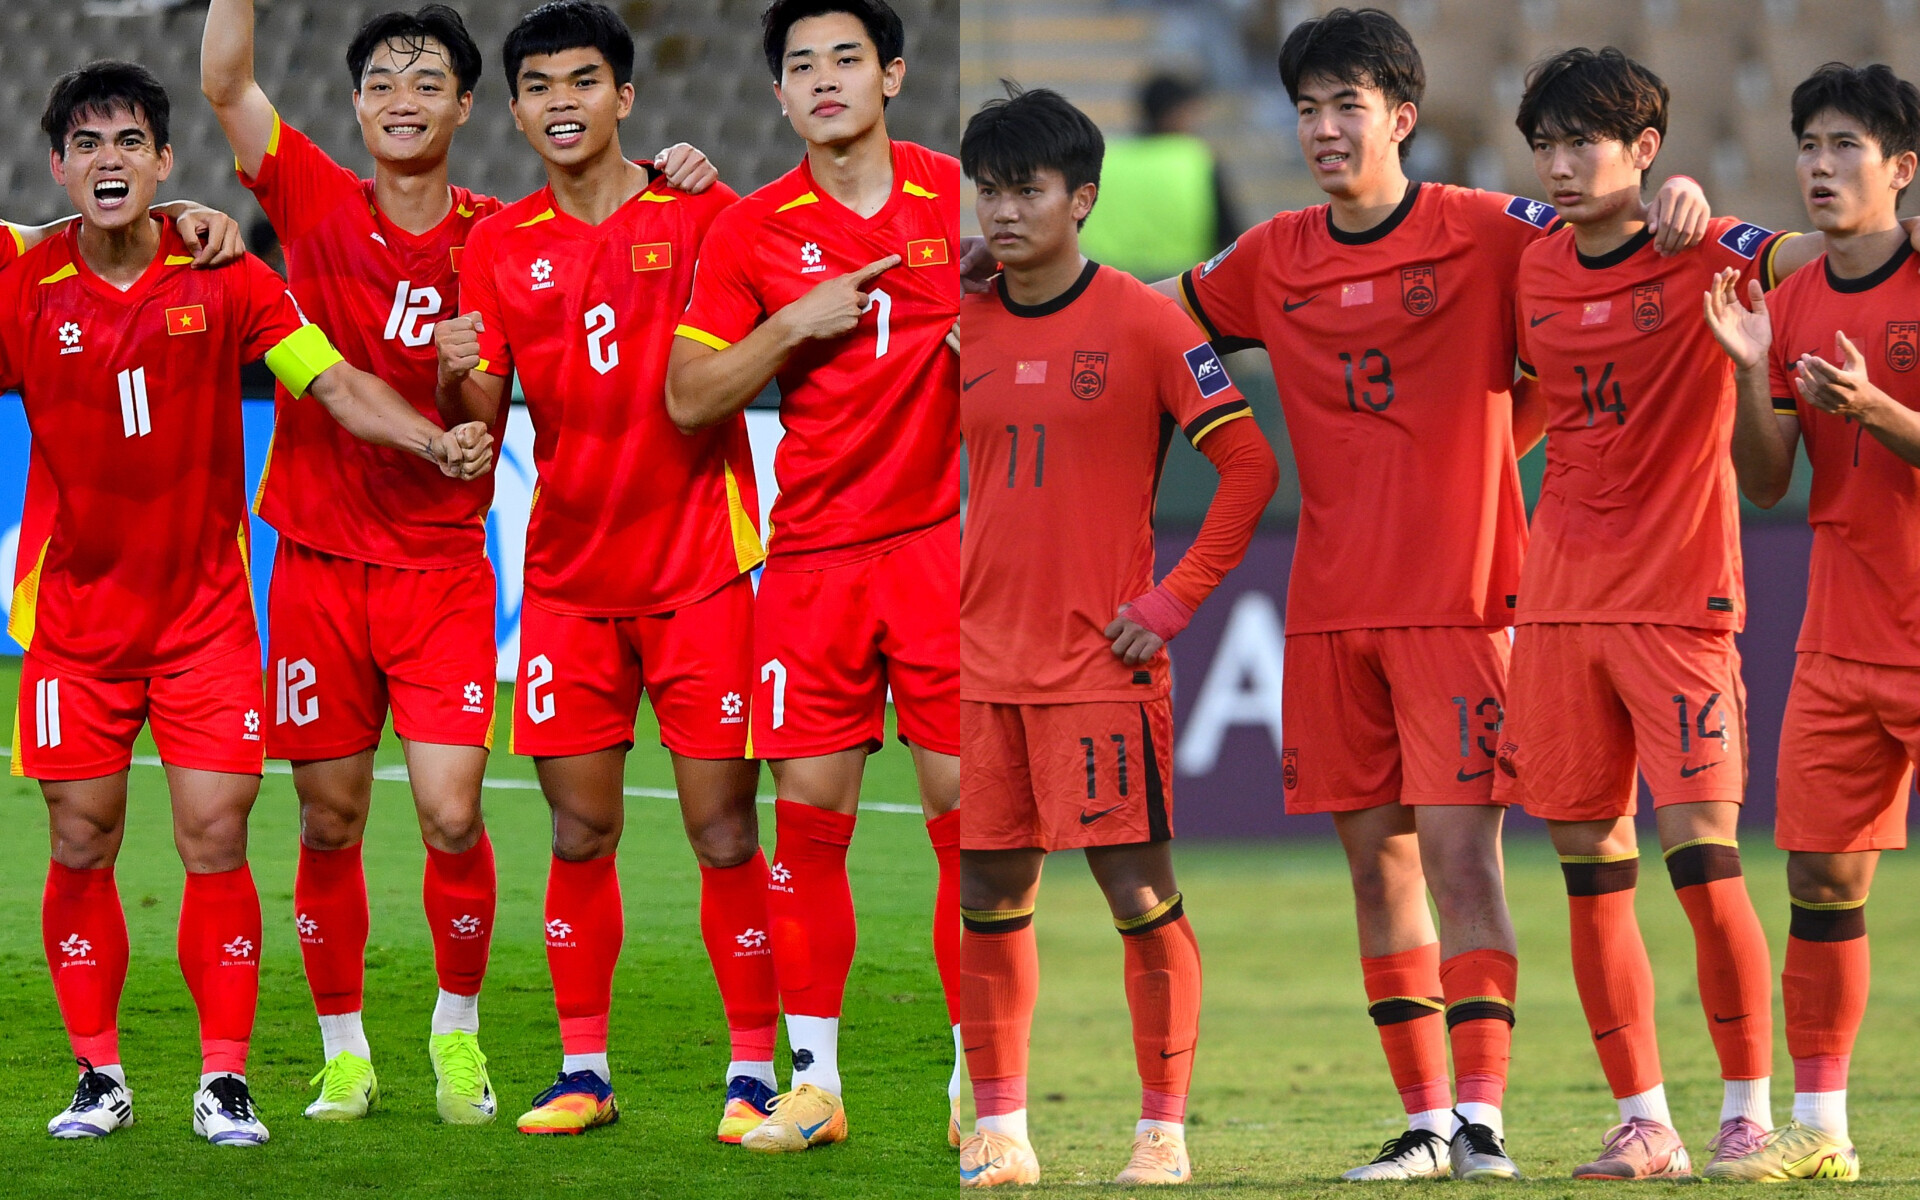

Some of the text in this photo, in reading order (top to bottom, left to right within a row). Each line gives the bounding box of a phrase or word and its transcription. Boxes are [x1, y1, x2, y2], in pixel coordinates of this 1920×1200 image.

[1525, 201, 1542, 222] AFC
[1737, 227, 1758, 250] AFC
[1403, 268, 1432, 280] CFA
[384, 281, 441, 347] 12
[584, 303, 618, 375] 2
[1889, 324, 1917, 334] CFA
[1076, 354, 1105, 365] CFA
[1198, 357, 1219, 379] AFC
[1339, 348, 1395, 412] 13
[118, 367, 151, 438] 11
[1574, 362, 1626, 426] 14
[1006, 424, 1045, 488] 11
[36, 678, 61, 749] 11
[276, 657, 320, 727] 12
[527, 654, 556, 725] 2
[761, 658, 787, 730] 7
[1452, 697, 1504, 759] 13
[1672, 693, 1730, 753] 14
[1080, 734, 1128, 799] 11
